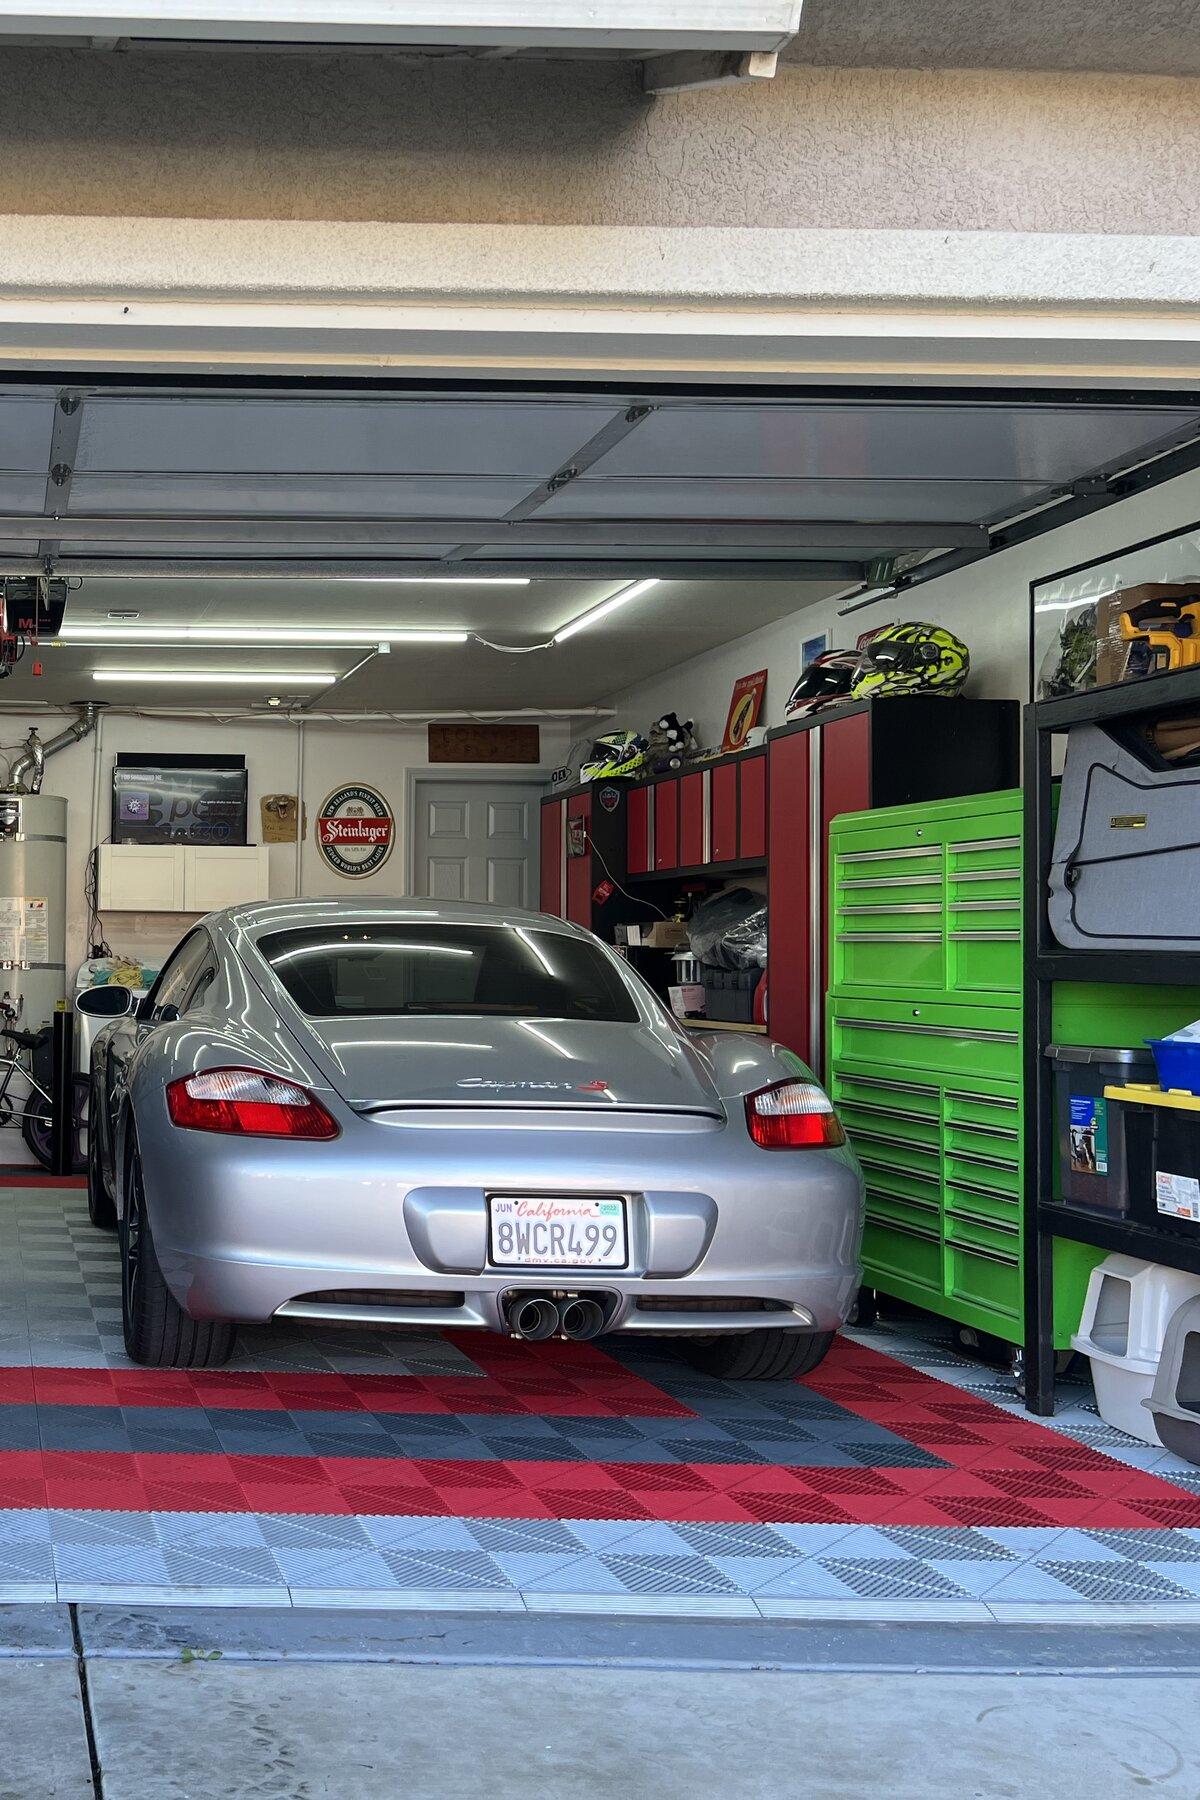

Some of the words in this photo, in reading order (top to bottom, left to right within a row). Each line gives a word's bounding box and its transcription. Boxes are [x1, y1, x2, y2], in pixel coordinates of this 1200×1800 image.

[326, 804, 335, 816] NEW
[333, 790, 357, 805] ZEALAND'S
[358, 790, 376, 805] FINEST
[373, 802, 384, 816] BEER
[322, 819, 388, 843] Steinlager
[326, 845, 341, 865] JUDGED
[340, 861, 361, 872] WORLD'S
[361, 860, 374, 871] BEST
[373, 846, 384, 862] LAGER
[495, 1203, 512, 1213] JUN
[516, 1200, 600, 1222] California
[498, 1222, 617, 1257] 8WCR499
